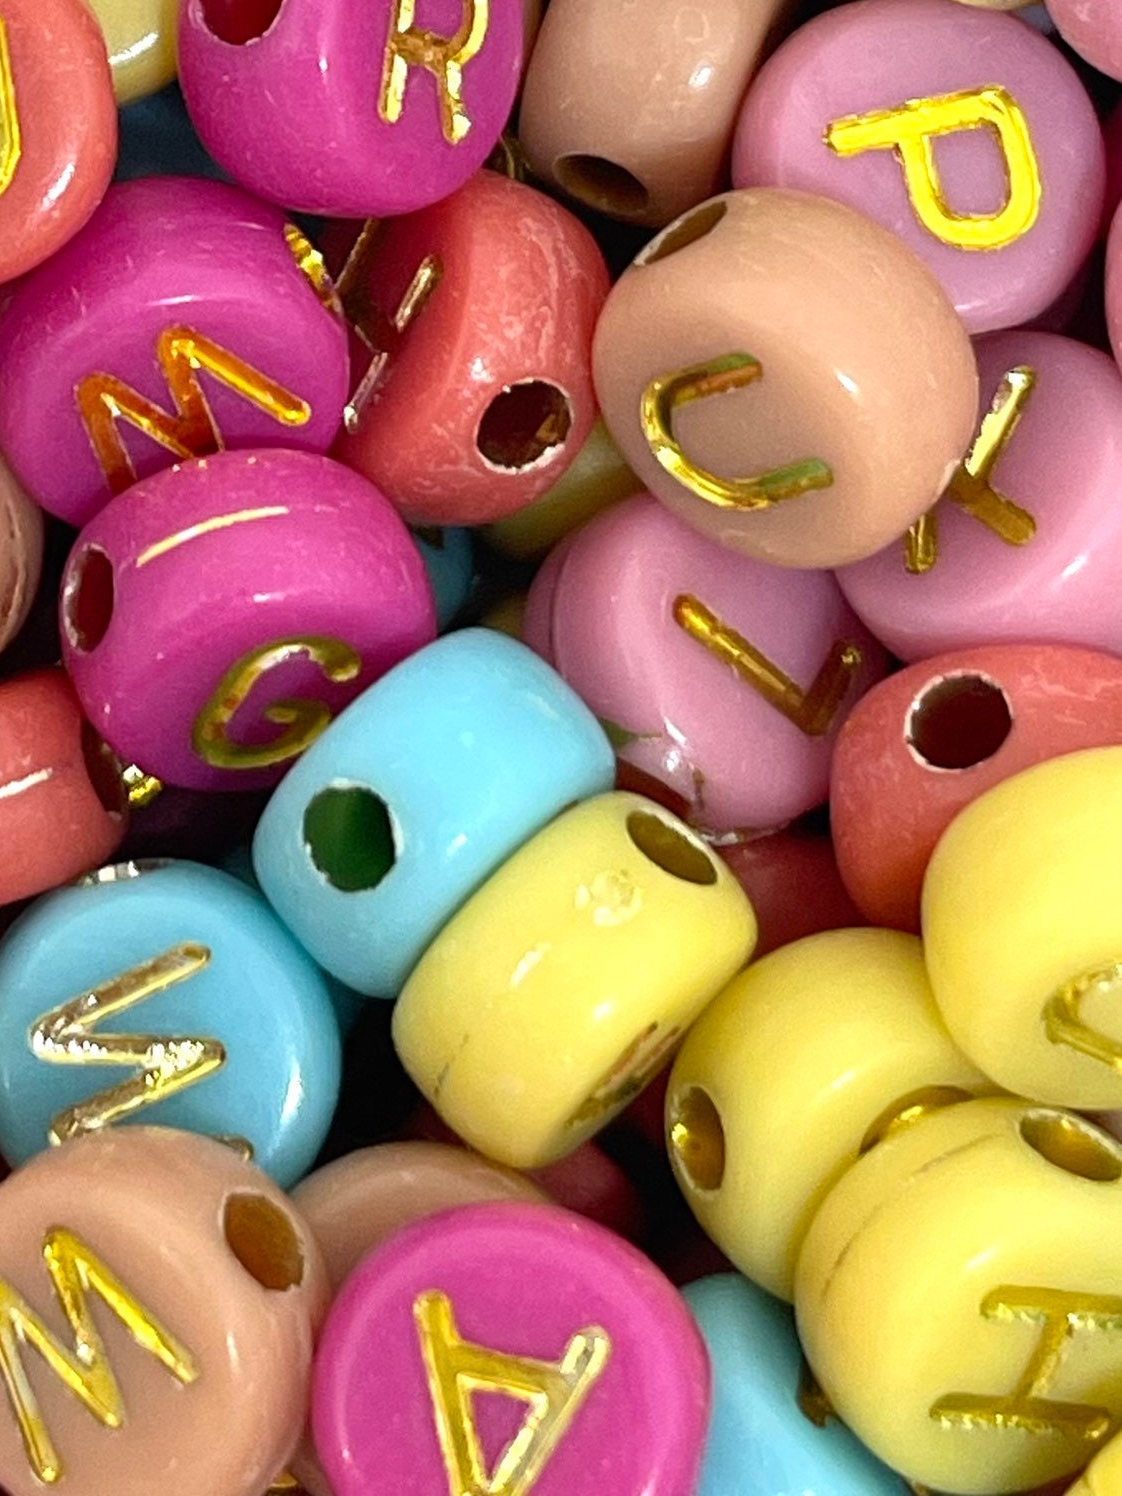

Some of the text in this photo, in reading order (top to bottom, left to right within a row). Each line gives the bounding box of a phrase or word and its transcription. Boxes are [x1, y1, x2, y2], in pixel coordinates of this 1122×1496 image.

[822, 82, 1042, 252] P
[188, 635, 362, 770] G
[413, 1286, 613, 1496] A
